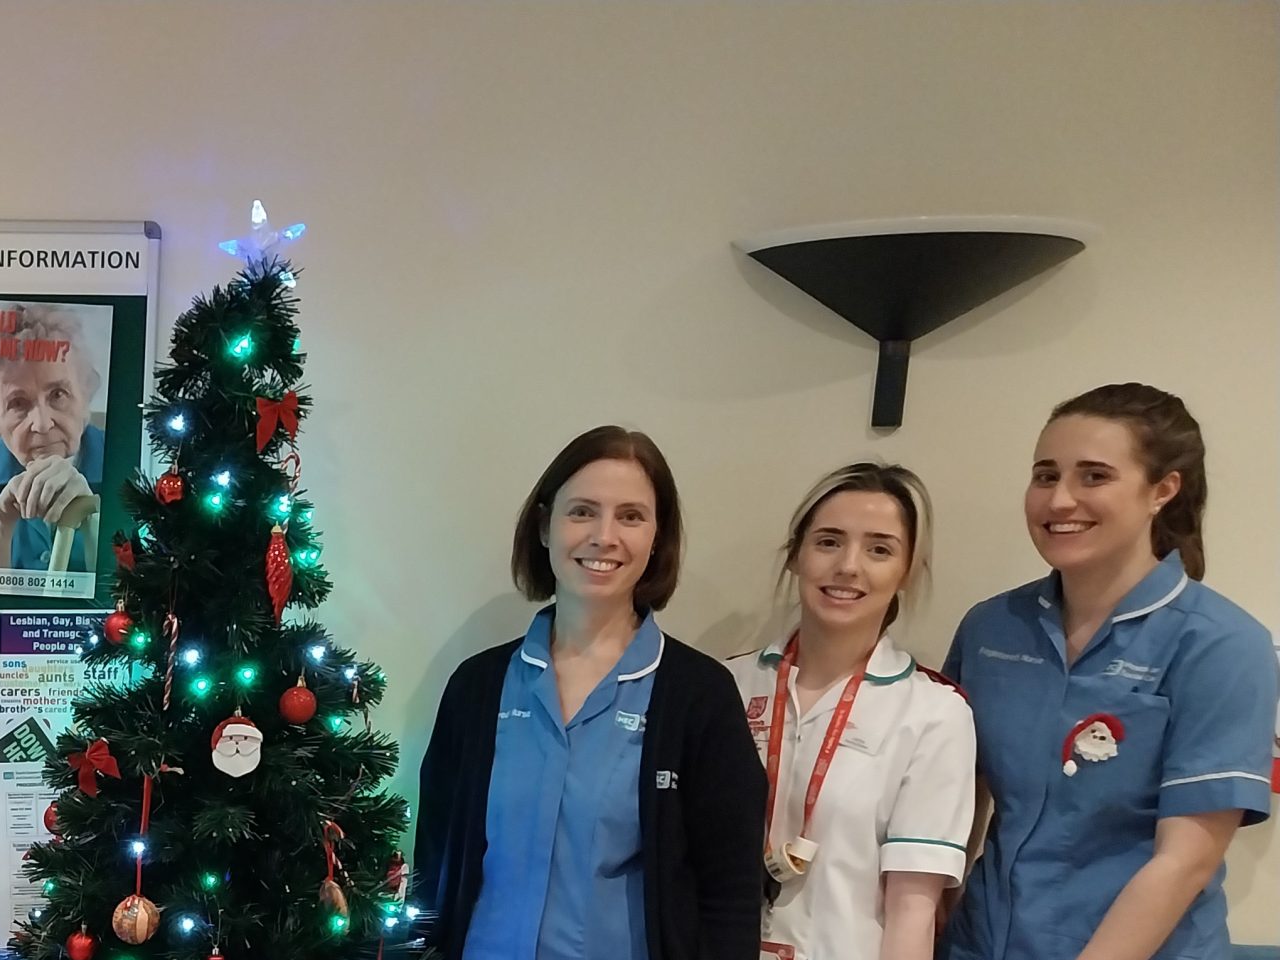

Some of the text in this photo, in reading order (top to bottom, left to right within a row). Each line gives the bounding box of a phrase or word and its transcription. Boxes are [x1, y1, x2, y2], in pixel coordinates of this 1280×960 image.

[0, 337, 21, 360] ME
[23, 339, 71, 363] NOW?
[0, 575, 75, 589] 0808 802 1414
[10, 616, 50, 626] Lesbian,
[52, 616, 73, 627] Gay,
[22, 630, 41, 638] and
[33, 642, 66, 652] People
[2, 660, 27, 668] sons
[38, 671, 75, 683] aunts
[84, 666, 119, 680] staff
[0, 687, 41, 697] carers
[48, 687, 84, 697] friends
[23, 696, 68, 706] mothers
[0, 705, 43, 714] broths
